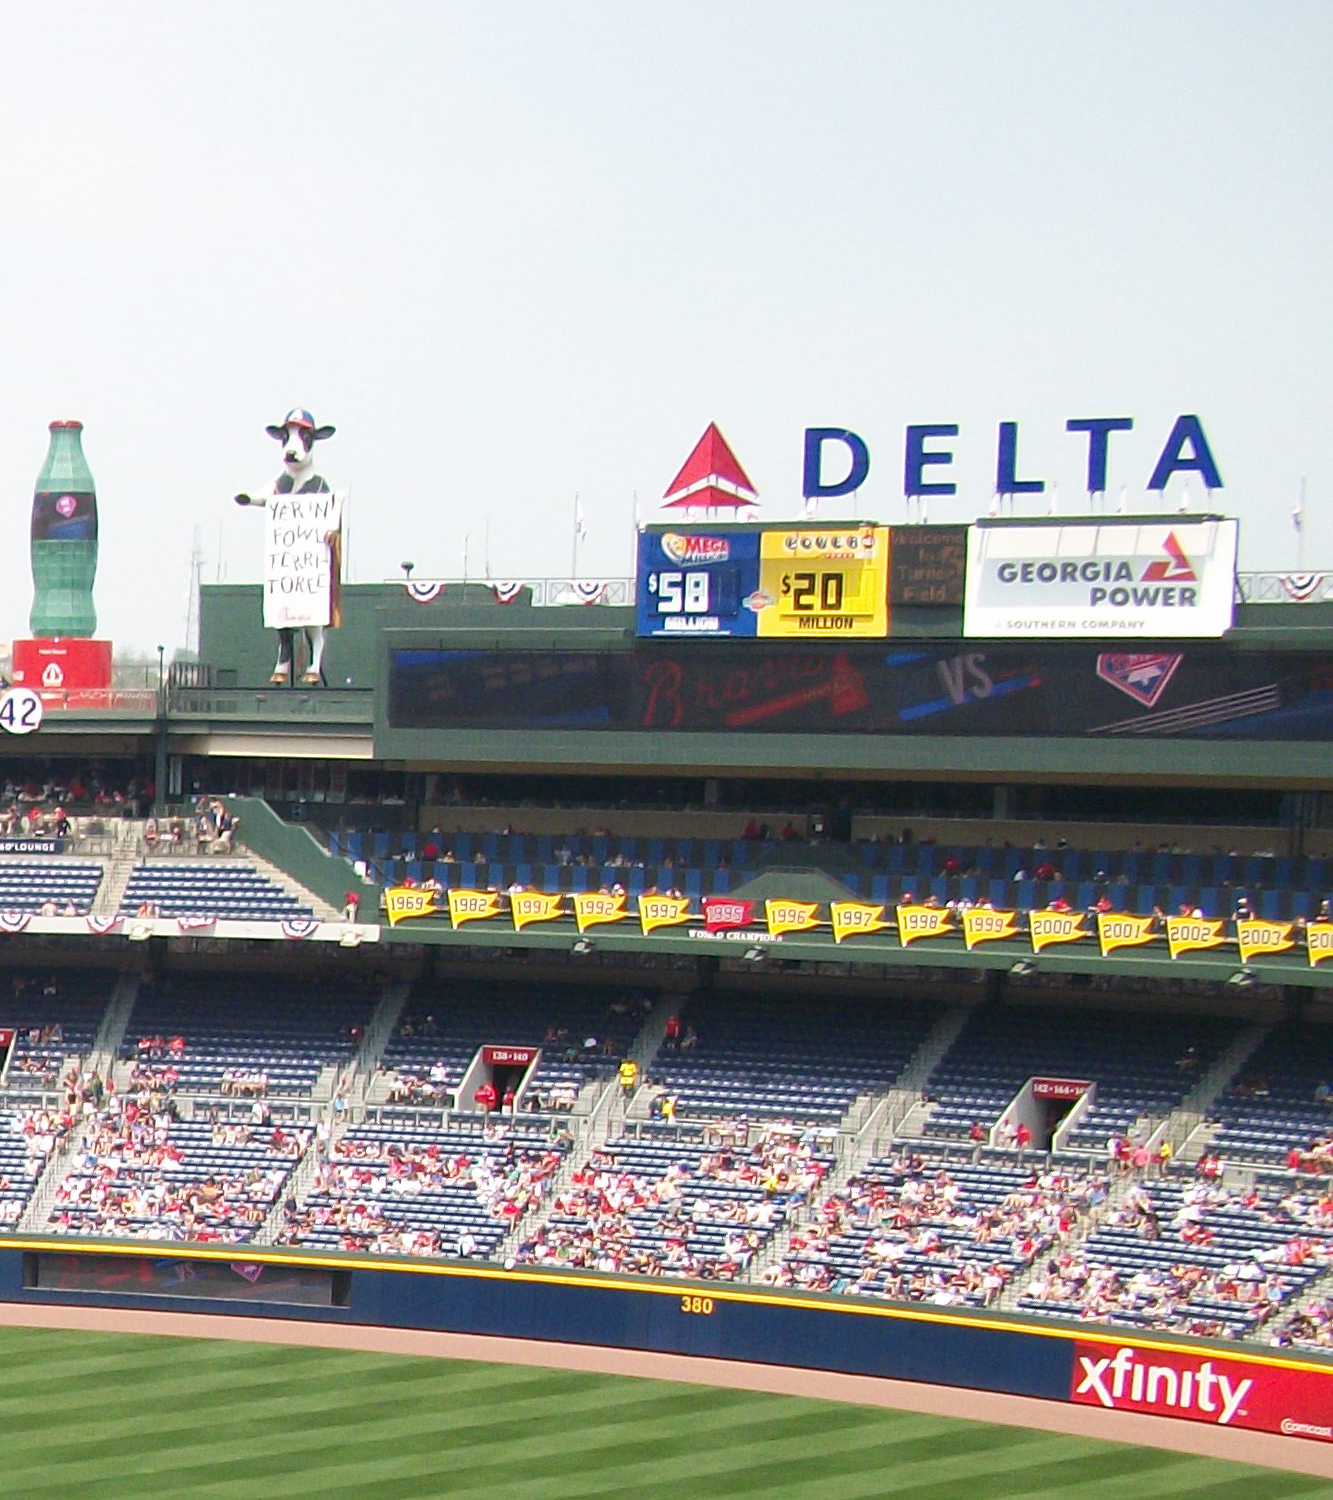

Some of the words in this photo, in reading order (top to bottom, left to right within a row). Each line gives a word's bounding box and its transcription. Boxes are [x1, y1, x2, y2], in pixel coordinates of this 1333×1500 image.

[802, 415, 1224, 498] DELTA
[269, 500, 304, 521] YER
[273, 524, 325, 547] FOWL
[996, 561, 1133, 584] GEORGIA
[1089, 586, 1197, 607] POWER
[798, 617, 853, 630] MILLION
[1006, 620, 1076, 629] SOUTHERN
[1082, 620, 1146, 630] COMPANY
[0, 697, 38, 727] 42
[391, 896, 425, 911] 1969
[454, 898, 488, 912] 1982
[517, 901, 549, 915] 1991
[579, 900, 614, 916] 1992
[644, 903, 678, 919] 1993
[707, 905, 744, 922] 1995
[771, 908, 806, 924] 1996
[836, 911, 871, 927] 1997
[902, 914, 937, 930] 1998
[968, 917, 1004, 933] 1999
[1033, 920, 1072, 935] 2000
[1103, 923, 1142, 939] 2001
[1170, 926, 1211, 942] 2002
[1241, 929, 1280, 946] 2003
[680, 1295, 713, 1314] 380
[1076, 1348, 1253, 1424] xfinity
